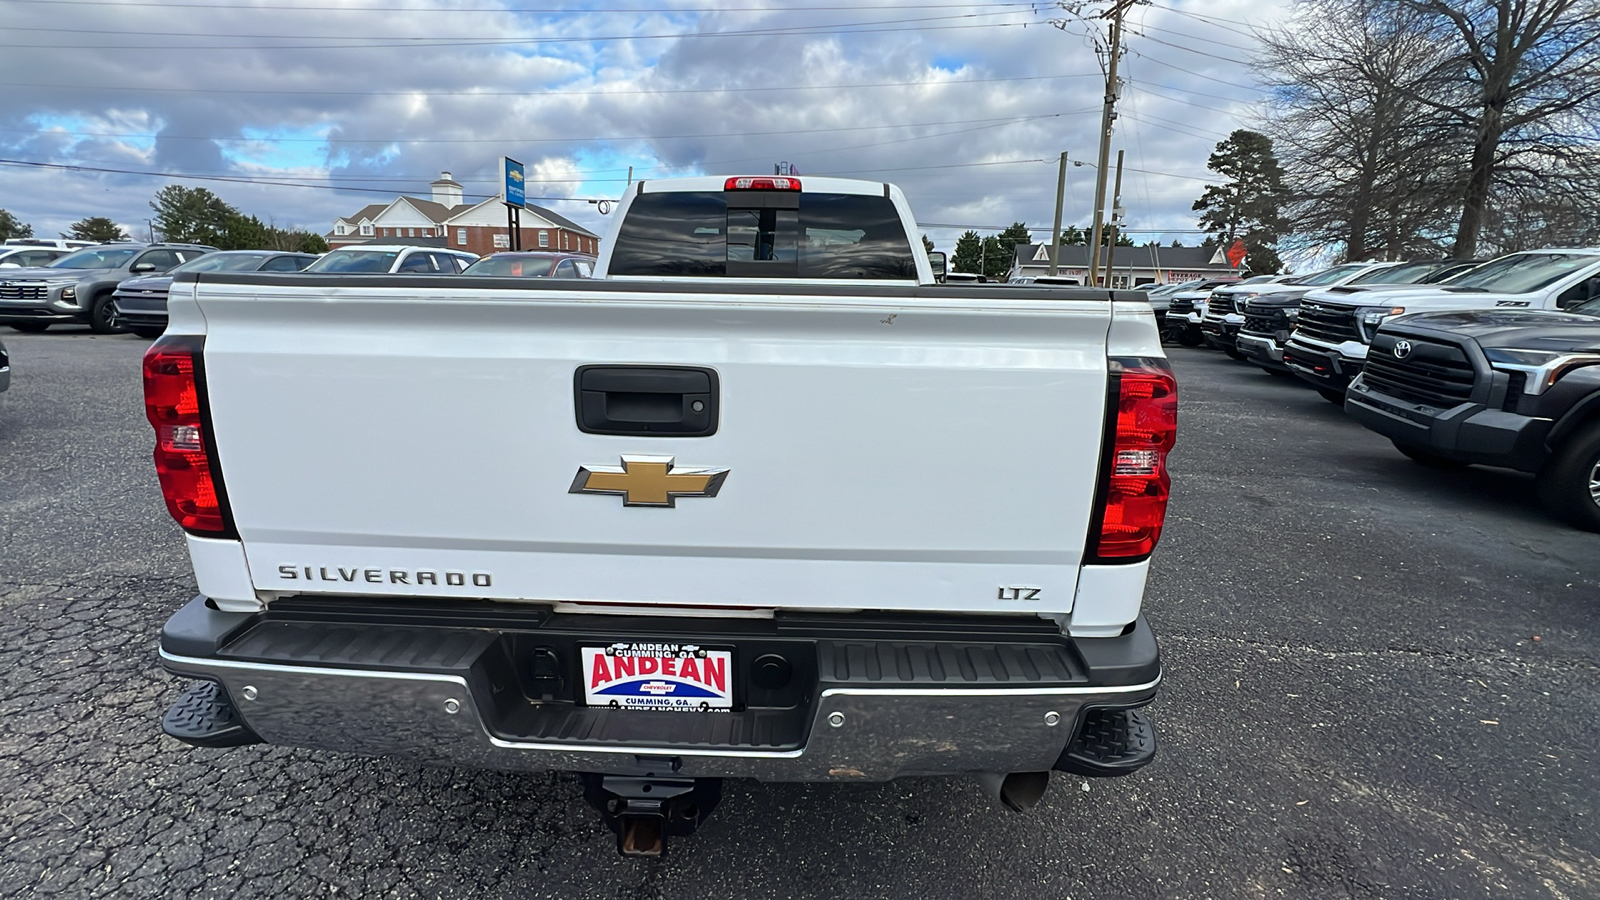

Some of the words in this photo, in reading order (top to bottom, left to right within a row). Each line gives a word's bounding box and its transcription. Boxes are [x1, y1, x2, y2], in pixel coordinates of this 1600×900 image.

[278, 565, 492, 587] SILVERADO
[998, 586, 1041, 600] LTZ
[631, 643, 679, 651] ANDEAN
[615, 649, 676, 658] CUMMING,
[679, 651, 696, 659] GA
[591, 653, 726, 693] ANDEAN
[625, 698, 674, 706] CUMMING,
